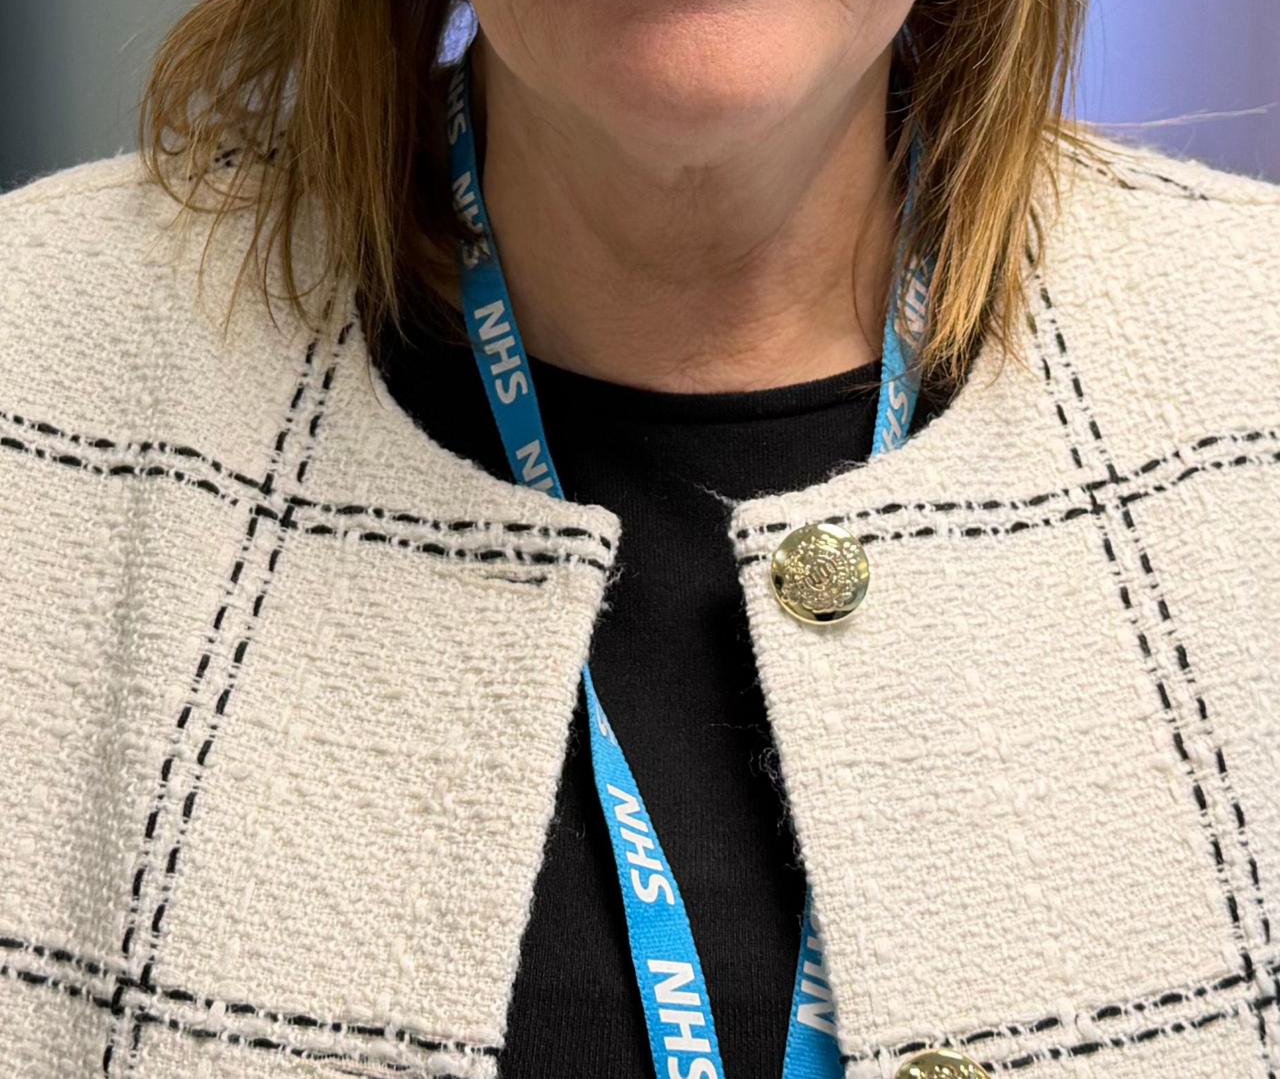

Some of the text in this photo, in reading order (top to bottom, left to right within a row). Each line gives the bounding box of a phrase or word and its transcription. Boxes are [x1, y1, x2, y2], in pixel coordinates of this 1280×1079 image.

[474, 299, 529, 405] NHS
[606, 783, 676, 906] NHS
[648, 958, 715, 1079] NHS
